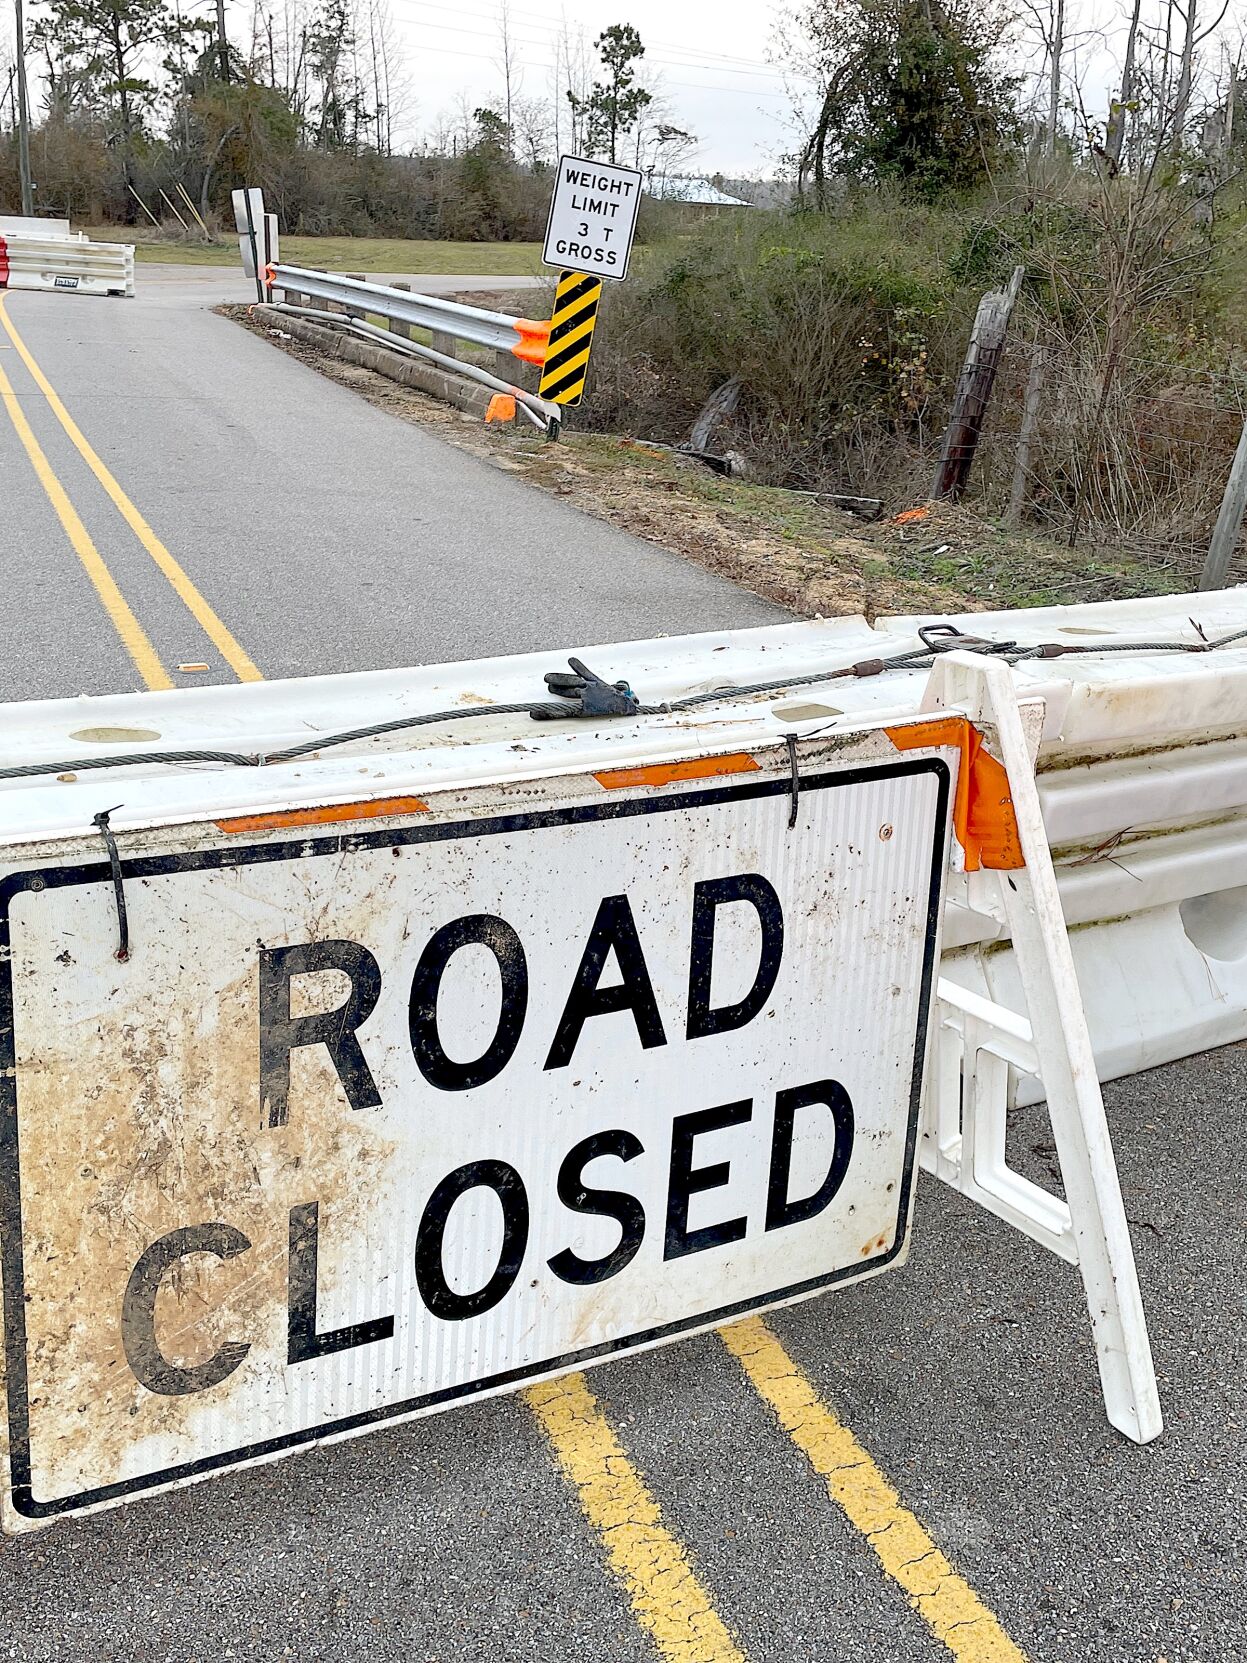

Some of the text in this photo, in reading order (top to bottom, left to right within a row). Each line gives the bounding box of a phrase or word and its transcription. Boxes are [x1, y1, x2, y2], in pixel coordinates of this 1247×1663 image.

[566, 168, 633, 196] WEIGHT
[572, 195, 619, 217] LIMIT
[578, 222, 613, 242] 3 T
[556, 240, 617, 265] GROSS
[258, 872, 784, 1129] ROAD
[120, 1078, 855, 1396] CLOSED
